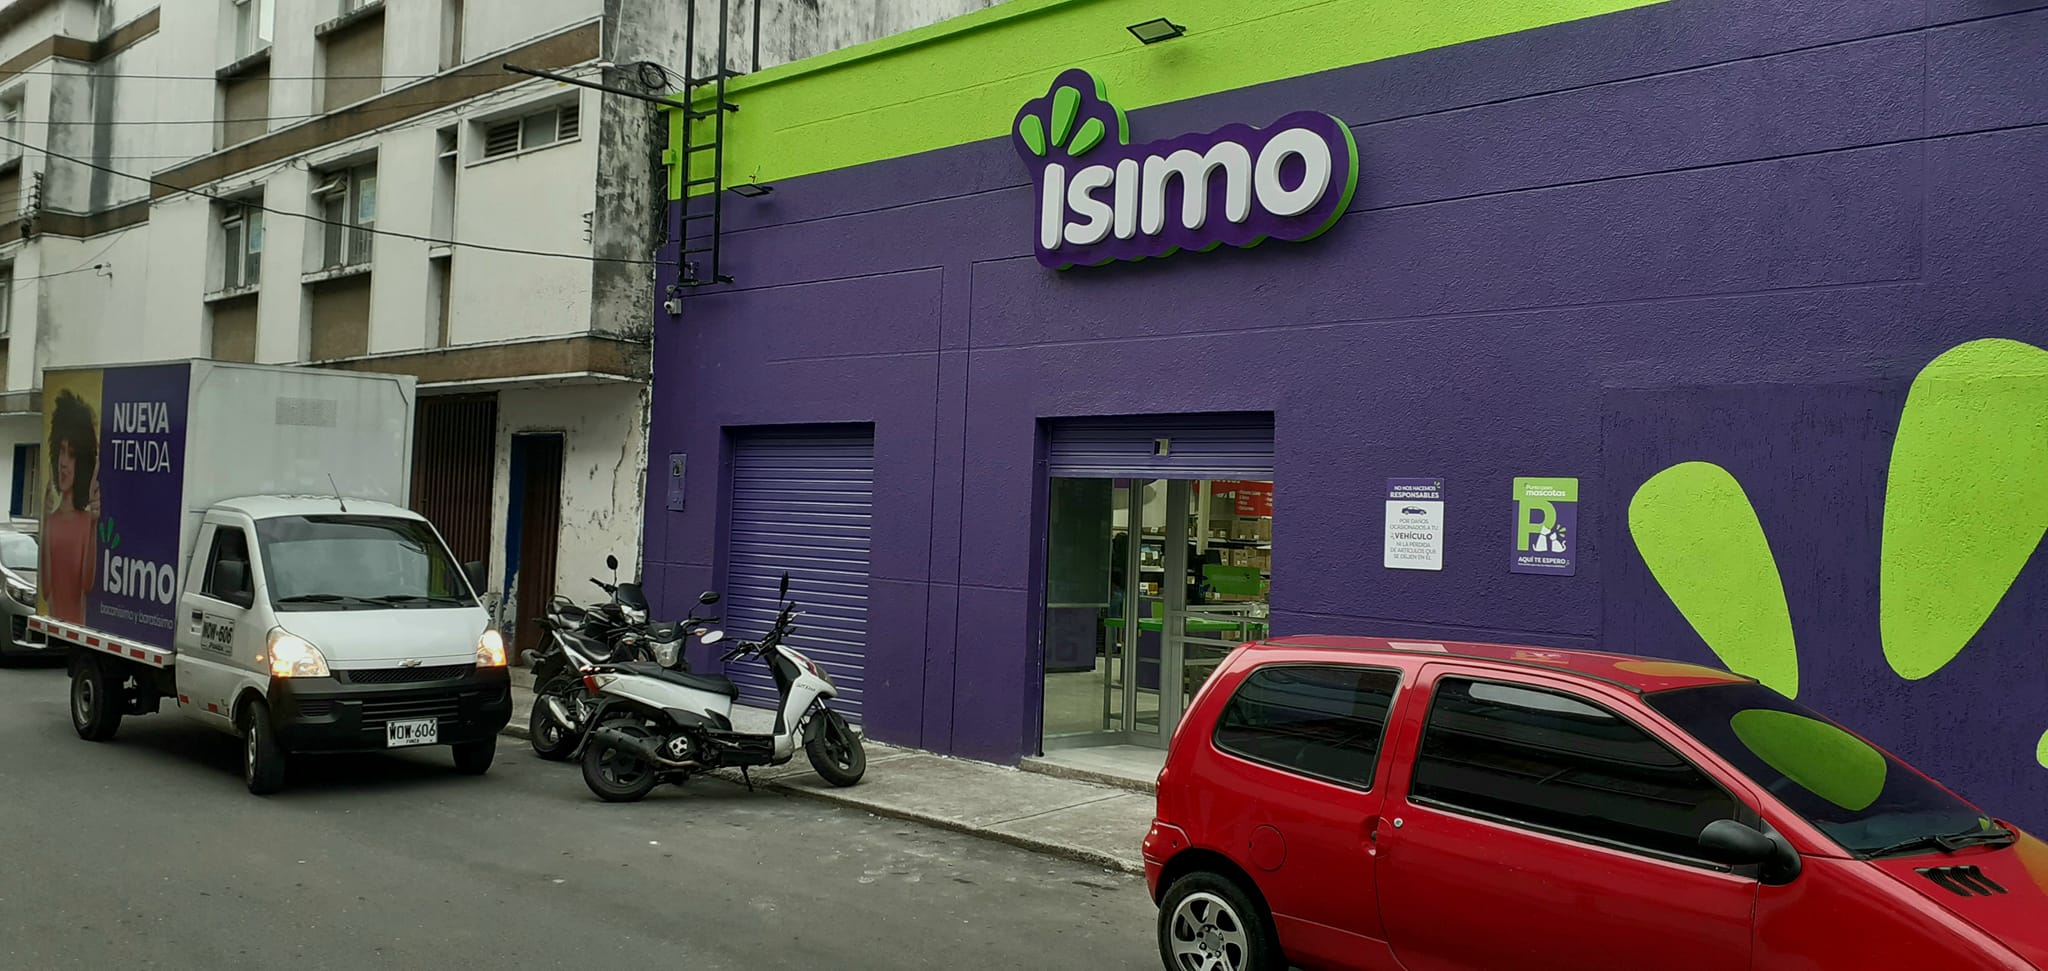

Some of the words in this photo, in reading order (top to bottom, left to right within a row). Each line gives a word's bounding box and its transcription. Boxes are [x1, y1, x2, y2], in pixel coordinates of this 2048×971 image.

[112, 402, 170, 434] NUEVA
[111, 439, 171, 473] TIENDA
[1390, 491, 1440, 499] RESPONSABLES
[1525, 489, 1566, 497] mascotas
[1394, 531, 1433, 540] VEHÍCULO
